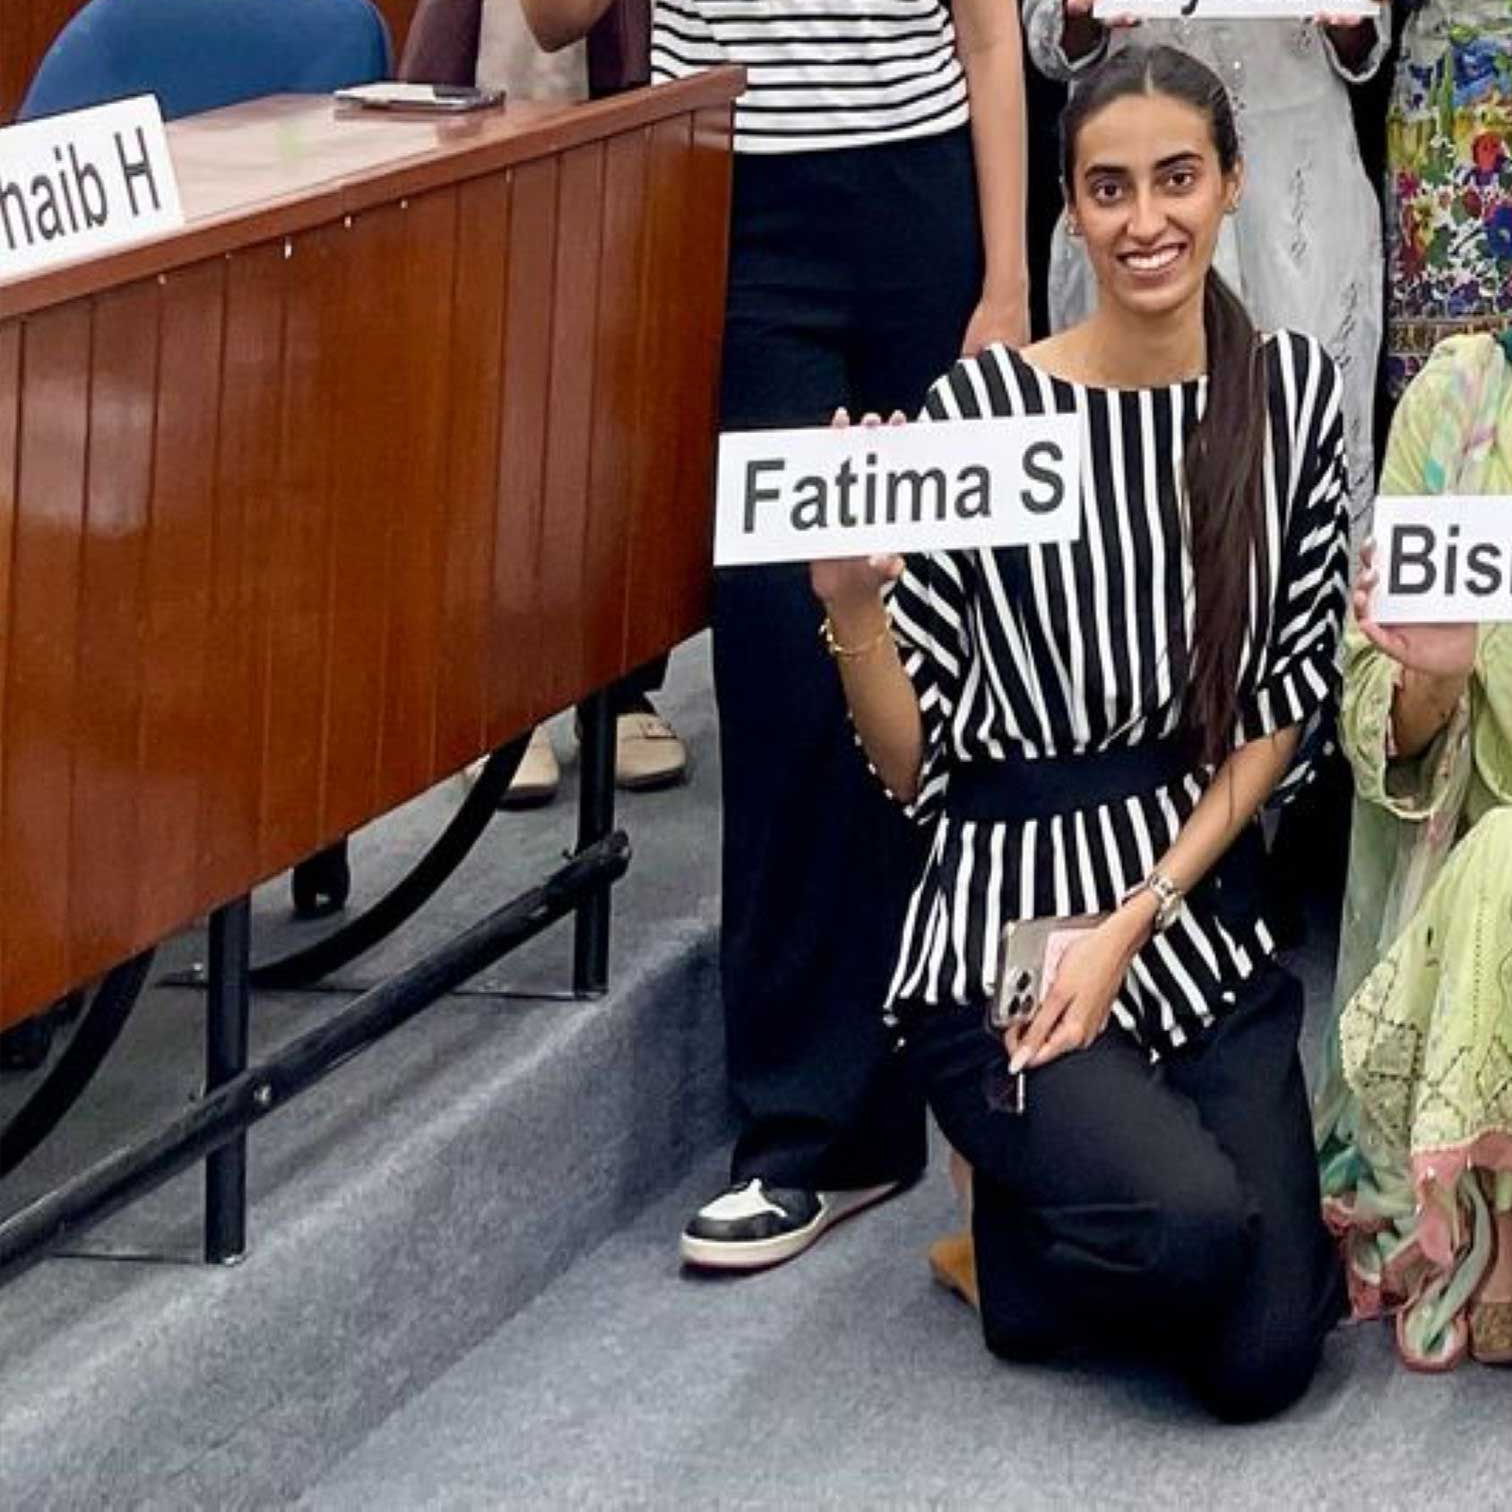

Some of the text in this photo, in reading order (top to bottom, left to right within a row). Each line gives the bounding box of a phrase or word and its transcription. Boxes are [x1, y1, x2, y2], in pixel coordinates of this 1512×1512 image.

[113, 125, 160, 217] H
[743, 441, 1065, 534] Fatima S
